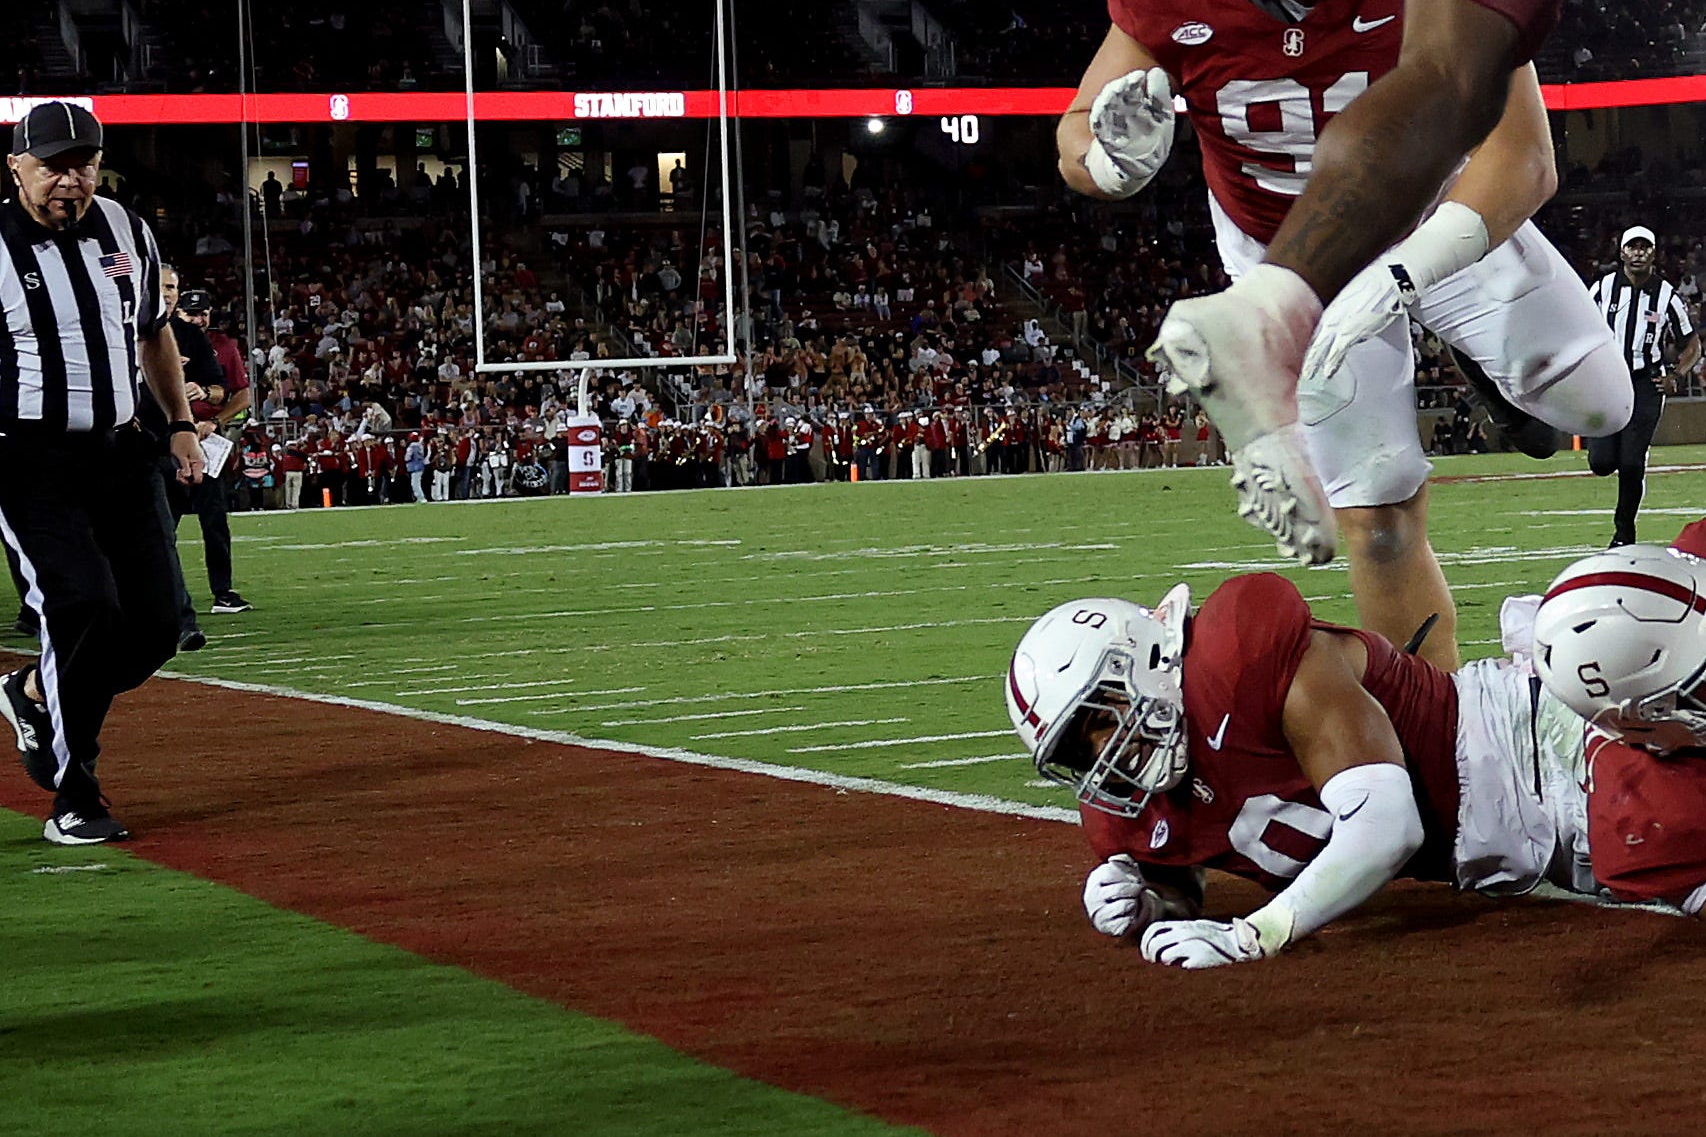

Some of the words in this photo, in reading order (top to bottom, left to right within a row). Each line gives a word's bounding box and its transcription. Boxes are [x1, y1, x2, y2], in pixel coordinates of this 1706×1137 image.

[574, 92, 685, 118] STANFORD
[941, 114, 979, 145] 40
[24, 271, 41, 290] S
[1645, 332, 1654, 344] R
[1577, 661, 1611, 699] S
